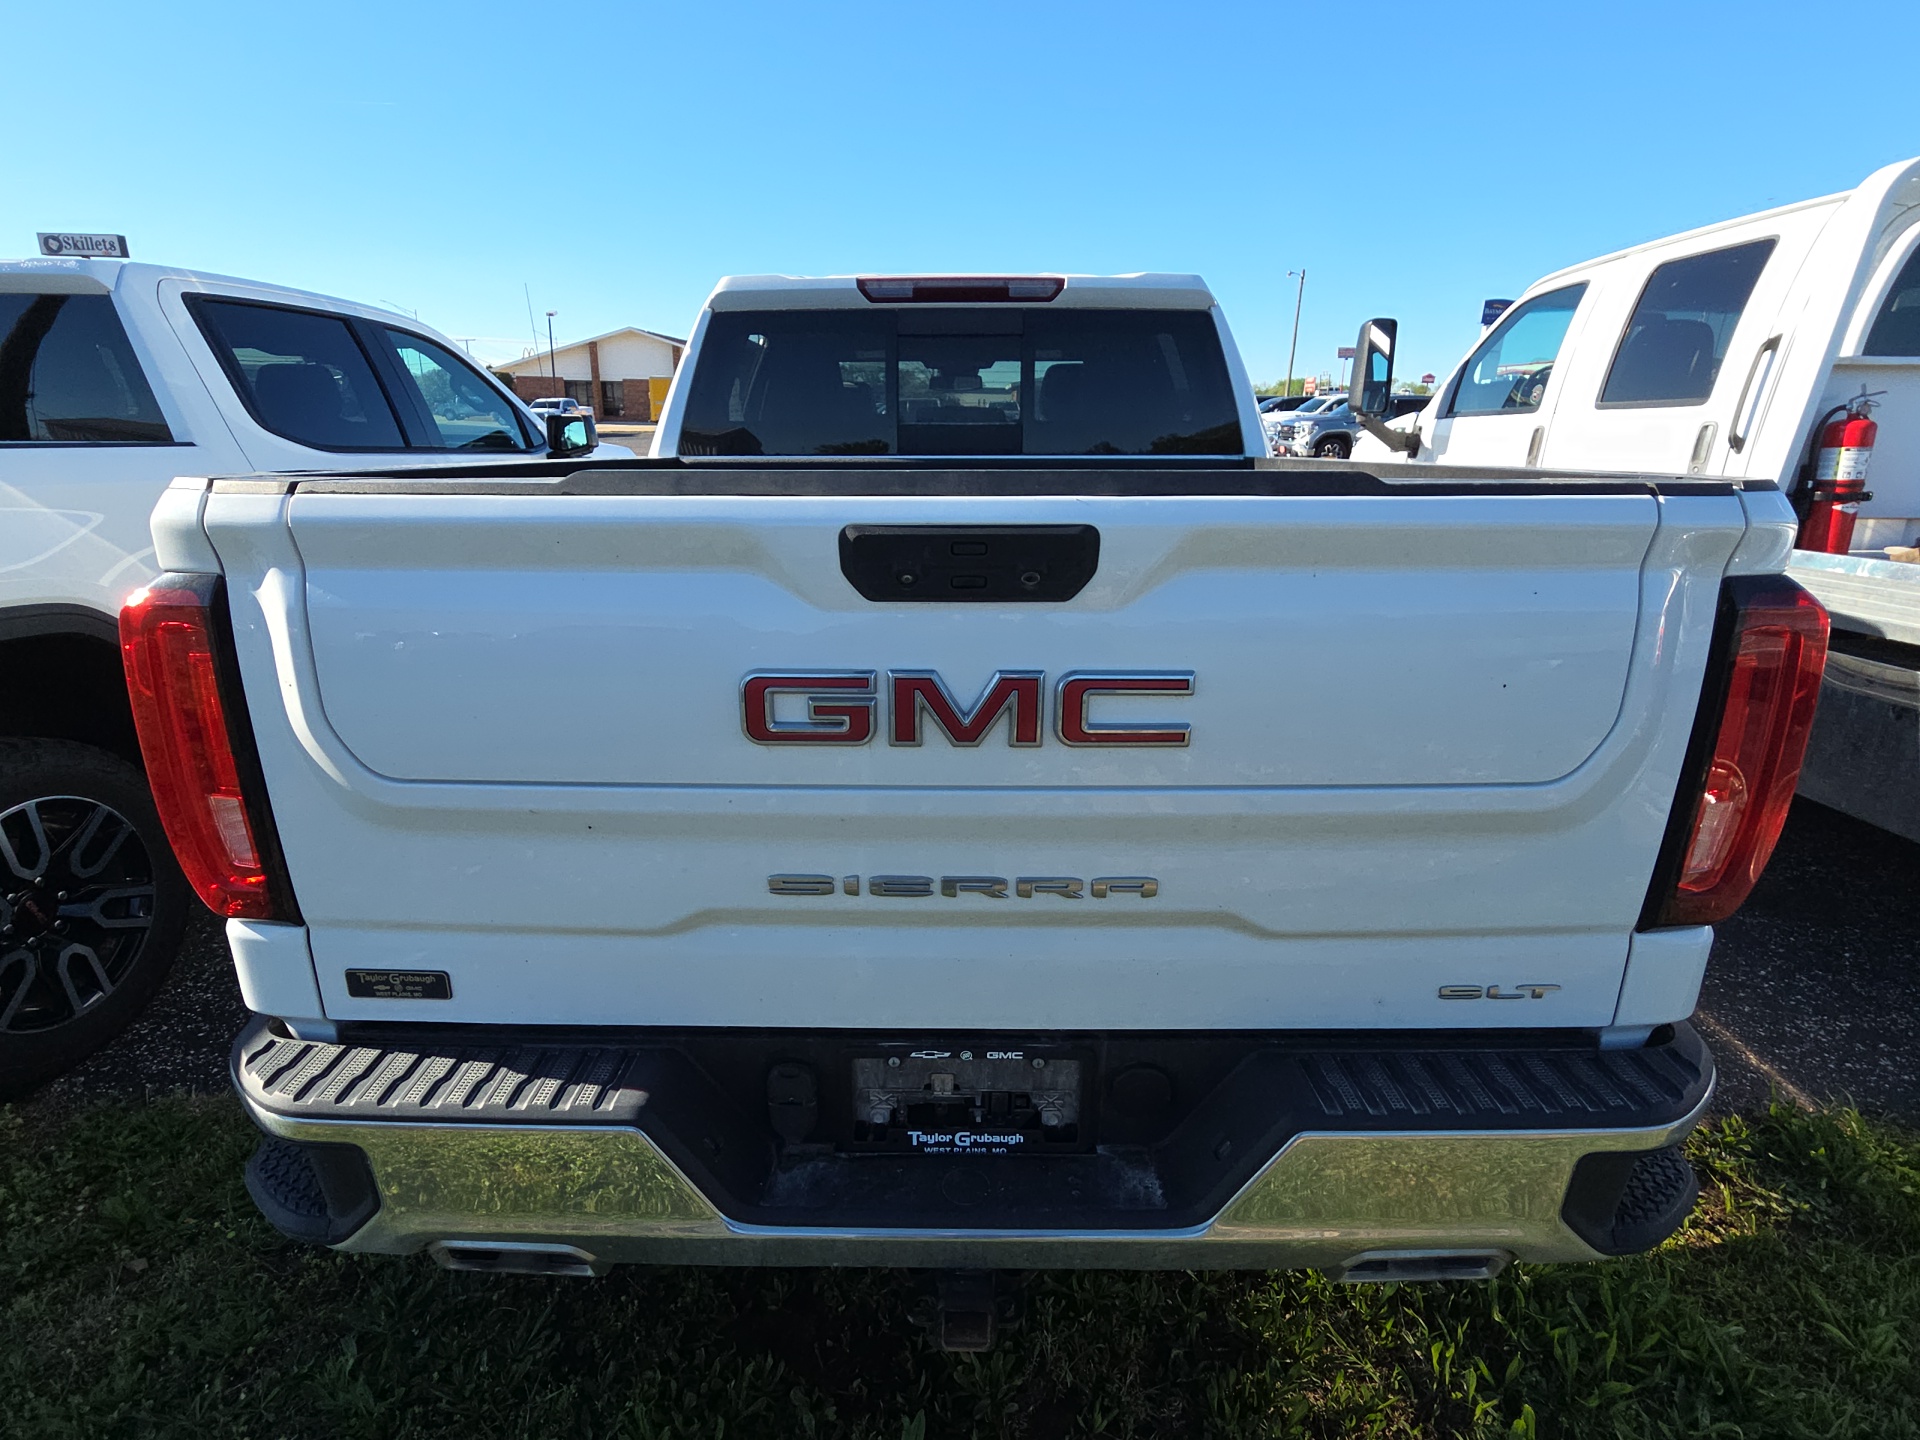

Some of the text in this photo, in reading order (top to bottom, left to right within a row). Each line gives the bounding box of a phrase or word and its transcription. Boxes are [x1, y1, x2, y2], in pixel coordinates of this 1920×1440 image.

[62, 235, 117, 252] Skillets
[739, 668, 1196, 748] GMC
[767, 873, 1160, 900] SIERRA
[356, 972, 436, 984] Taylor Grubaugh
[1438, 984, 1562, 1000] SLT
[986, 1051, 1024, 1060] GMC
[907, 1131, 1024, 1147] Taylor Grubaugh
